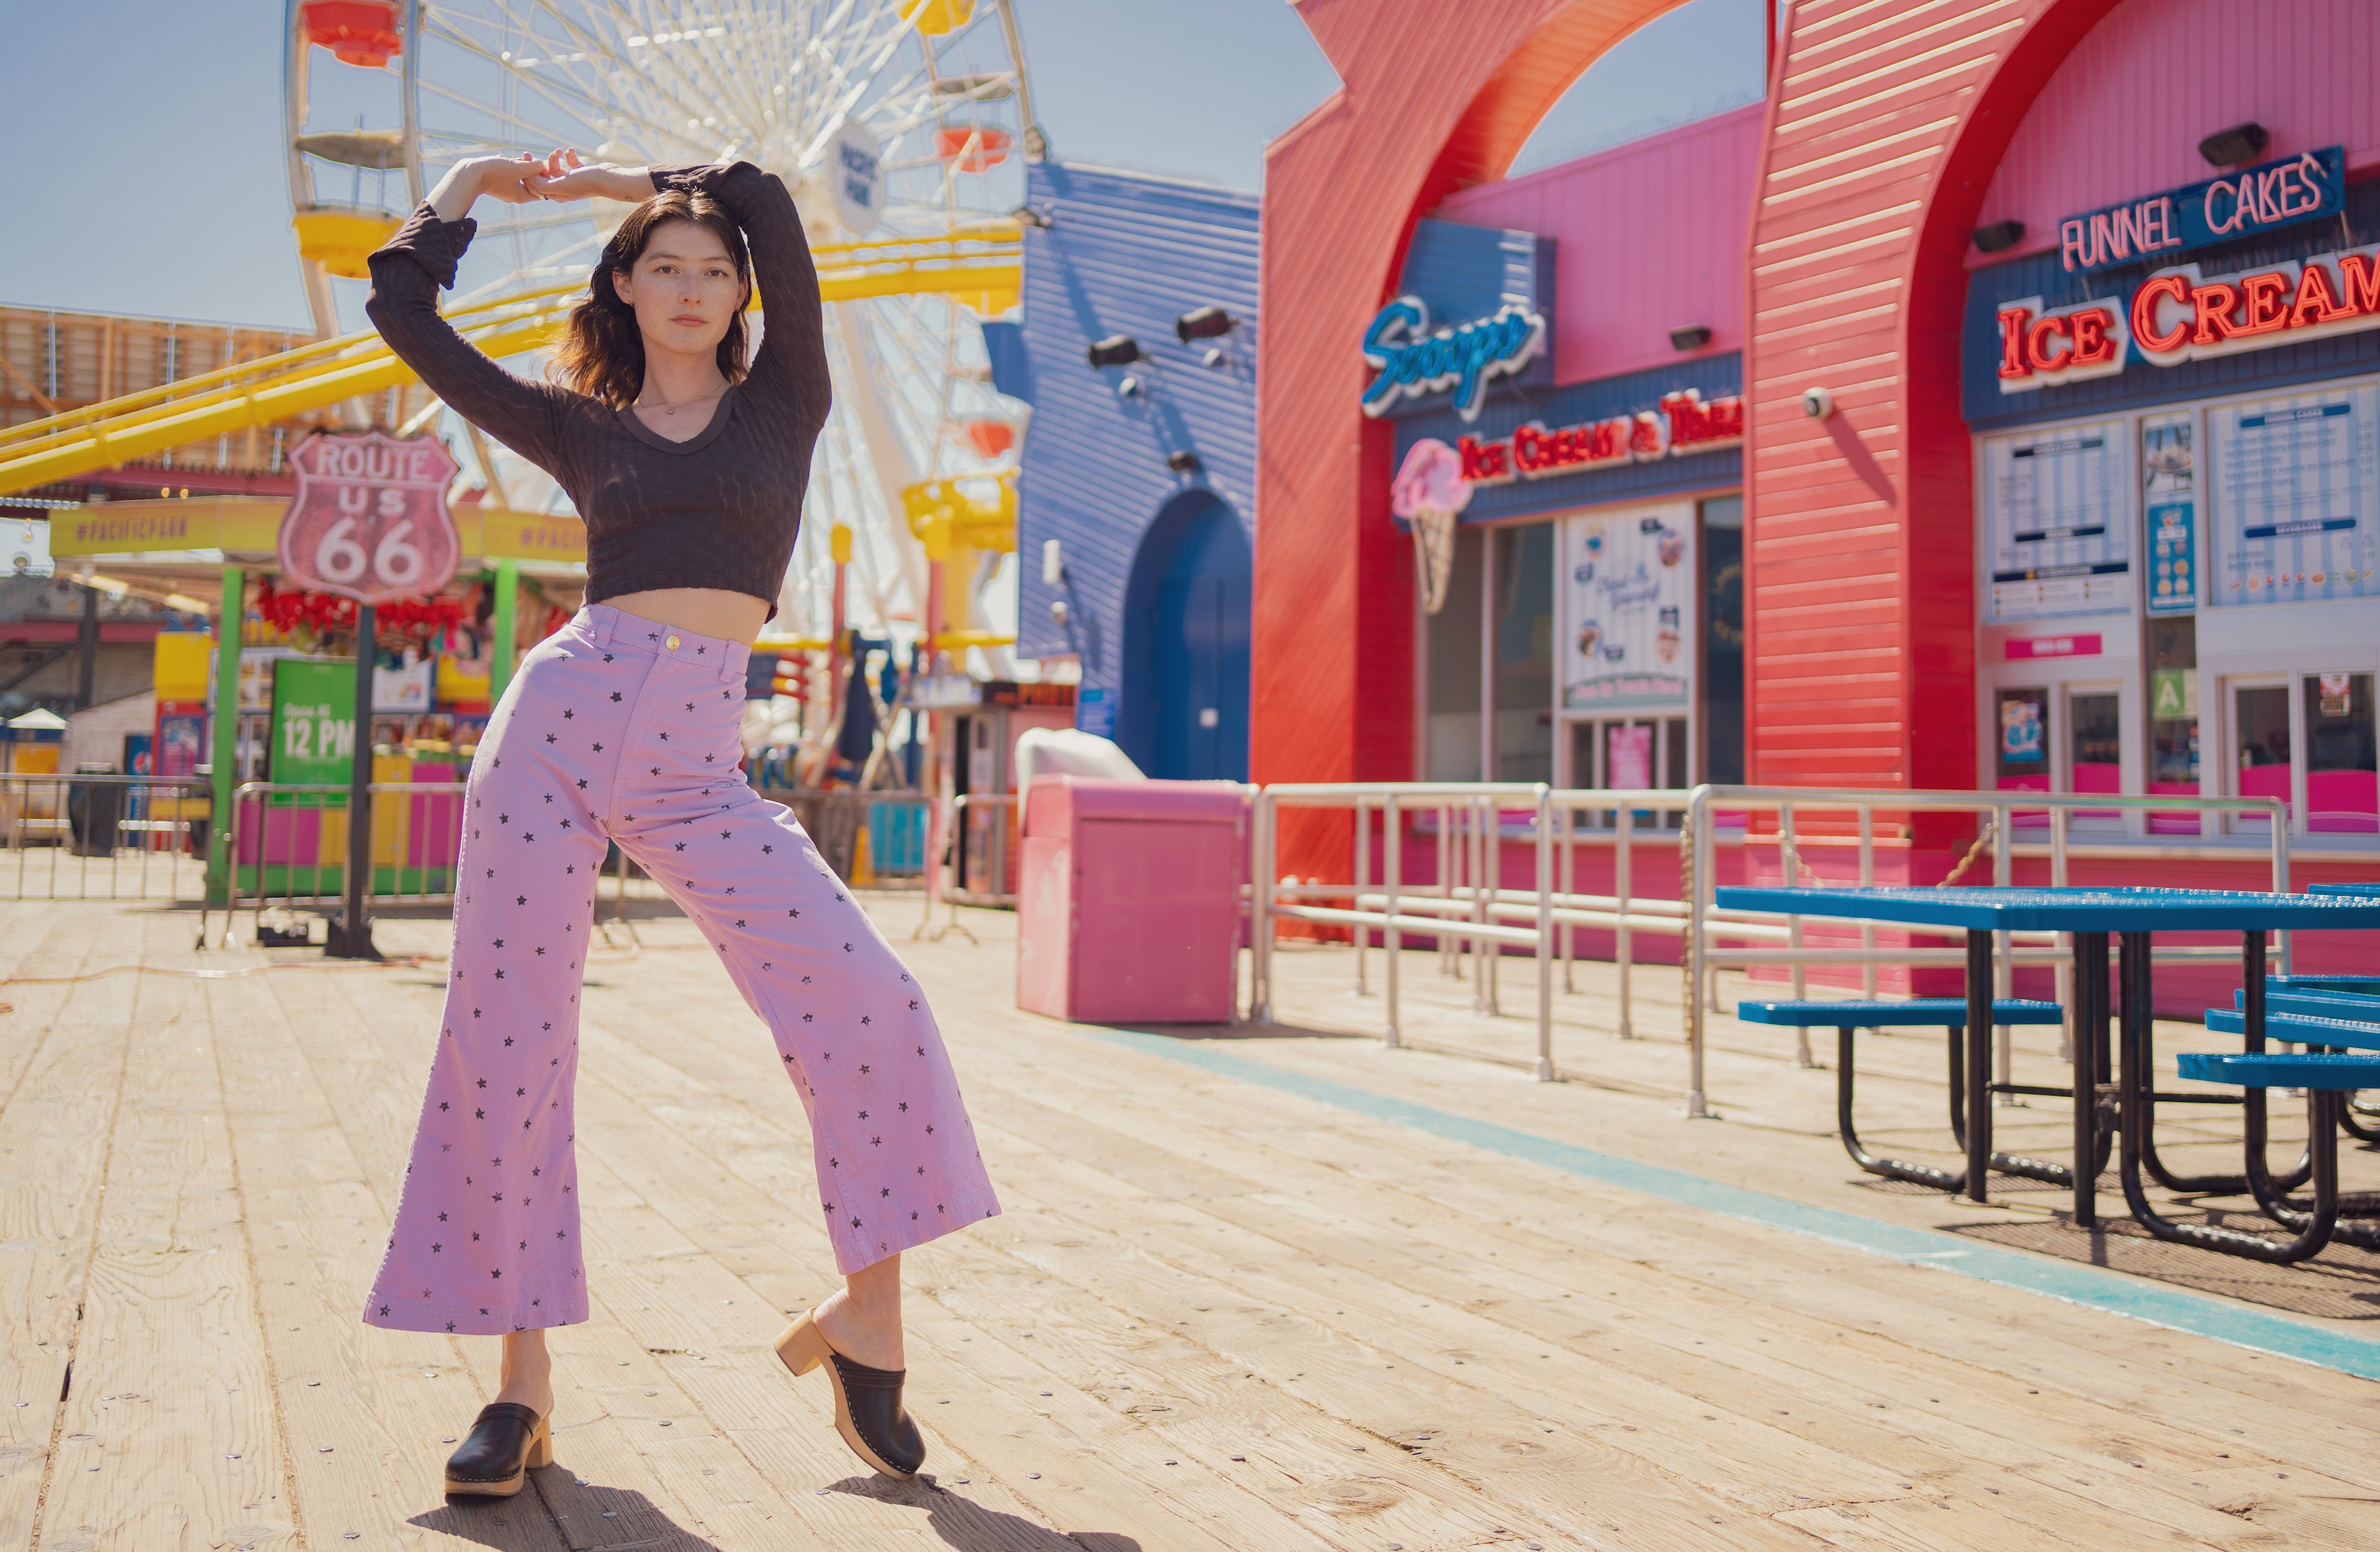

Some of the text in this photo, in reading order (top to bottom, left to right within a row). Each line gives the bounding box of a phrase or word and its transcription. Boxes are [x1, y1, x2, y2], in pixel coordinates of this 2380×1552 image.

[2061, 156, 2322, 271] FUNNEL CAKES
[1998, 249, 2380, 379] ICE CREAM
[1362, 301, 1528, 408] Scoops
[2264, 414, 2295, 424] FUNNEL
[317, 442, 431, 482] ROUTE
[1458, 436, 1509, 480] ICE
[1514, 420, 1628, 472] CREAM
[315, 515, 423, 586] 66
[2159, 680, 2180, 707] A
[283, 719, 356, 757] 12 PM
